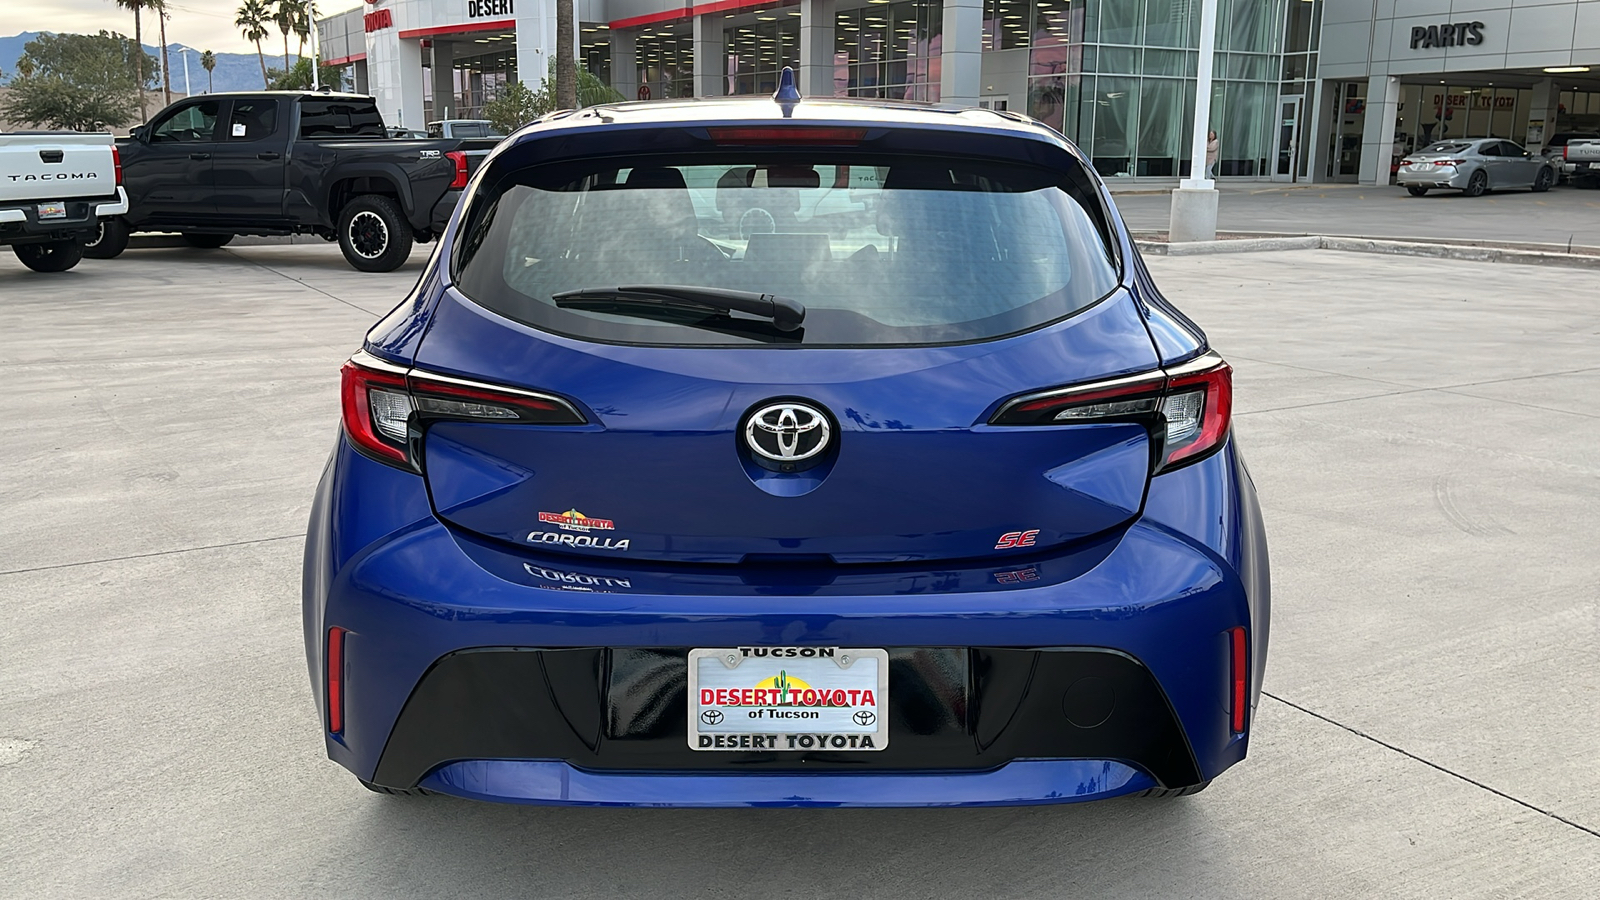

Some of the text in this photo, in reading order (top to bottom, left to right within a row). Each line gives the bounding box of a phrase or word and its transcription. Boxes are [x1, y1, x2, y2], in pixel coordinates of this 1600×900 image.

[469, 0, 514, 18] DESERT
[364, 9, 393, 33] TOYOTA
[1410, 21, 1484, 49] PARTS
[8, 173, 97, 181] TACOMA
[538, 512, 615, 529] DESERT TOYOTA
[527, 531, 630, 551] COROLLA
[994, 529, 1040, 550] SE
[740, 648, 835, 657] TUCSON
[701, 688, 876, 706] DESERT TOYOTA
[748, 708, 819, 719] of Tucson
[698, 735, 875, 748] DESERT TOYOTA
